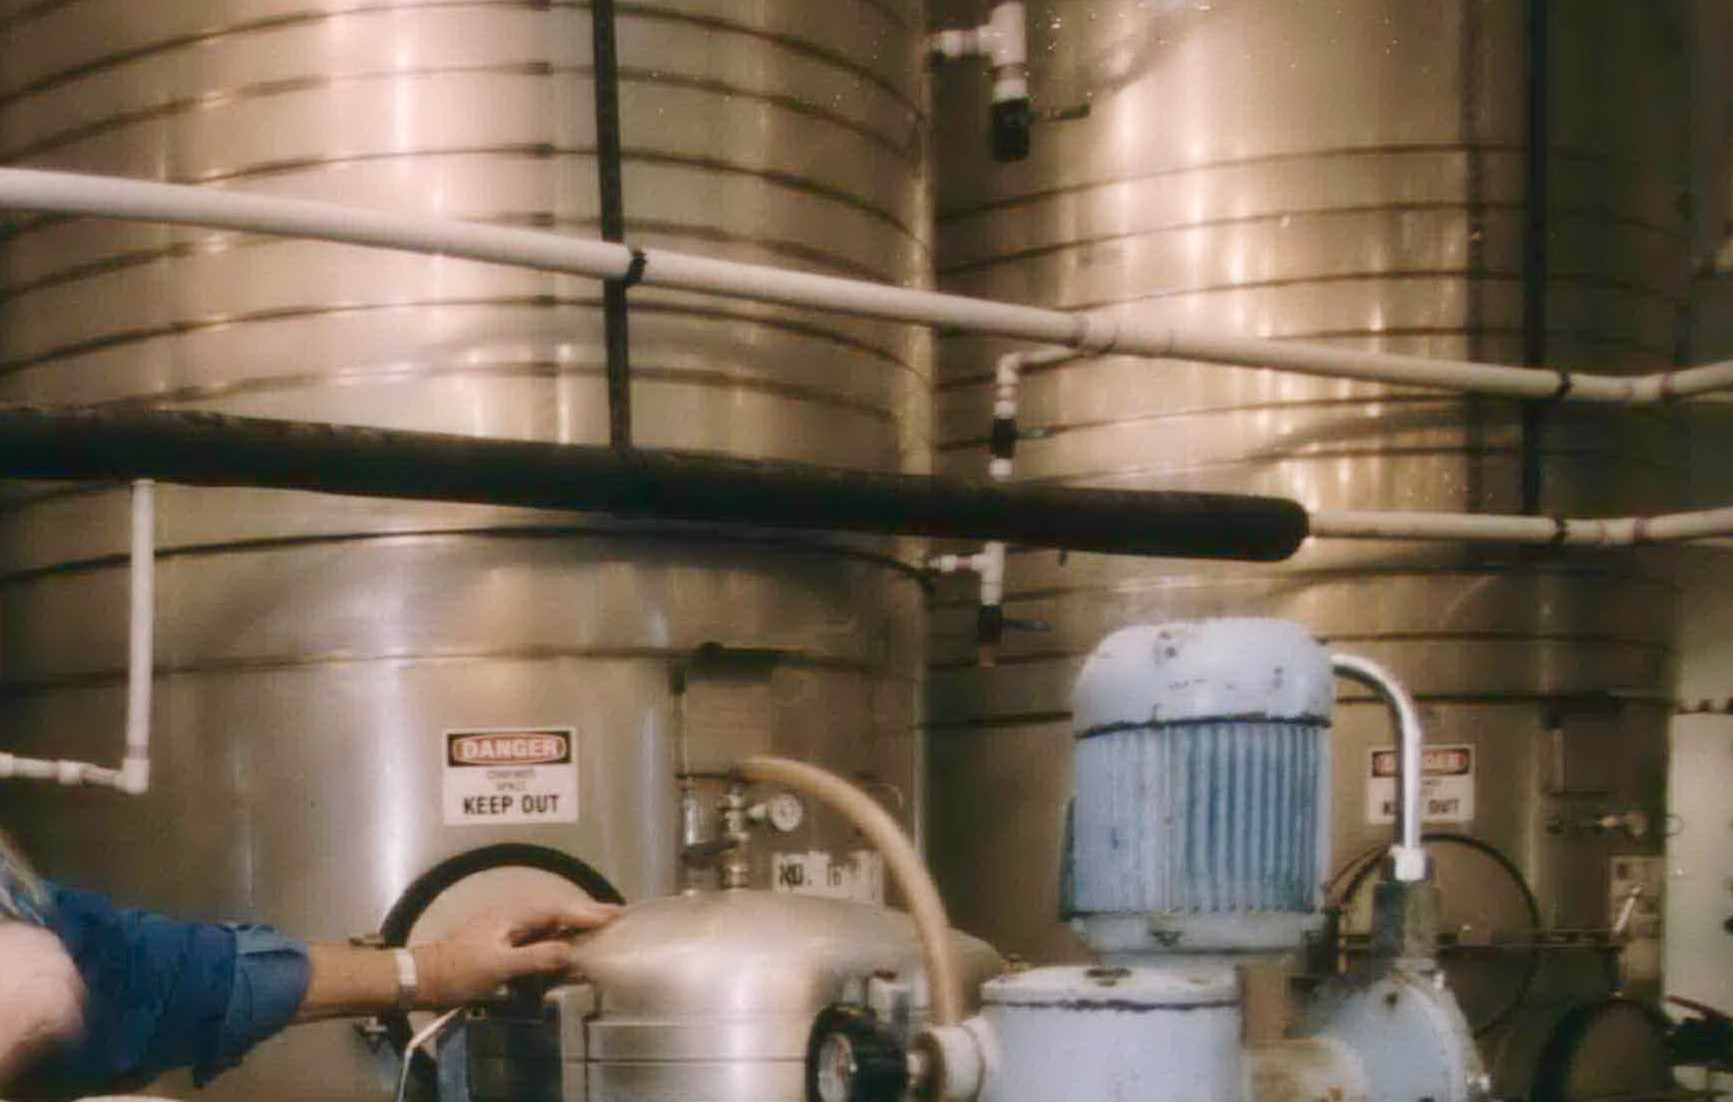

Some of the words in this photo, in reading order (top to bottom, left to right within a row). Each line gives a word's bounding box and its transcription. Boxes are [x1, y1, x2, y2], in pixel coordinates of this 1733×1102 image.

[462, 738, 558, 759] DANGER
[463, 795, 514, 815] KEEP
[521, 794, 560, 813] OUT
